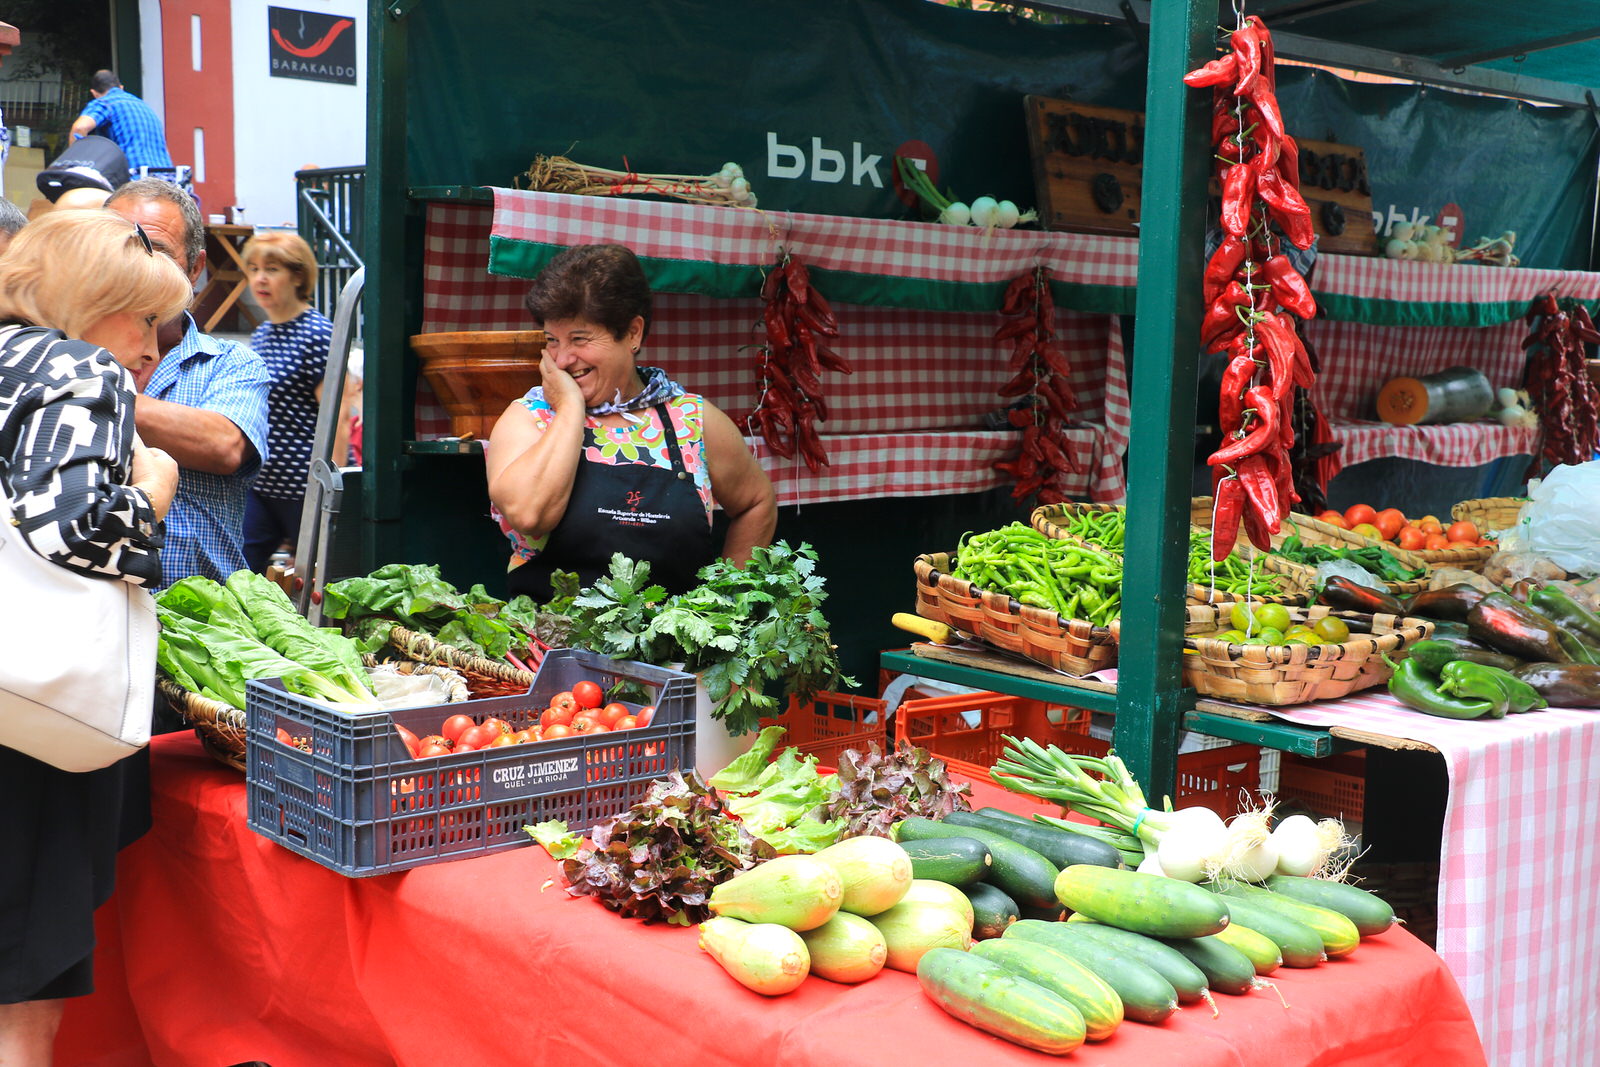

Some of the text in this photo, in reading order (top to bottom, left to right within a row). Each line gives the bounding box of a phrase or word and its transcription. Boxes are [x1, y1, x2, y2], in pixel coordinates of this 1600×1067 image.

[272, 58, 355, 78] BARAKALDO
[767, 131, 884, 189] bbk
[493, 765, 525, 783] CRUZ
[504, 780, 525, 789] QUEL
[533, 777, 543, 785] LA
[545, 773, 568, 783] RIOJA
